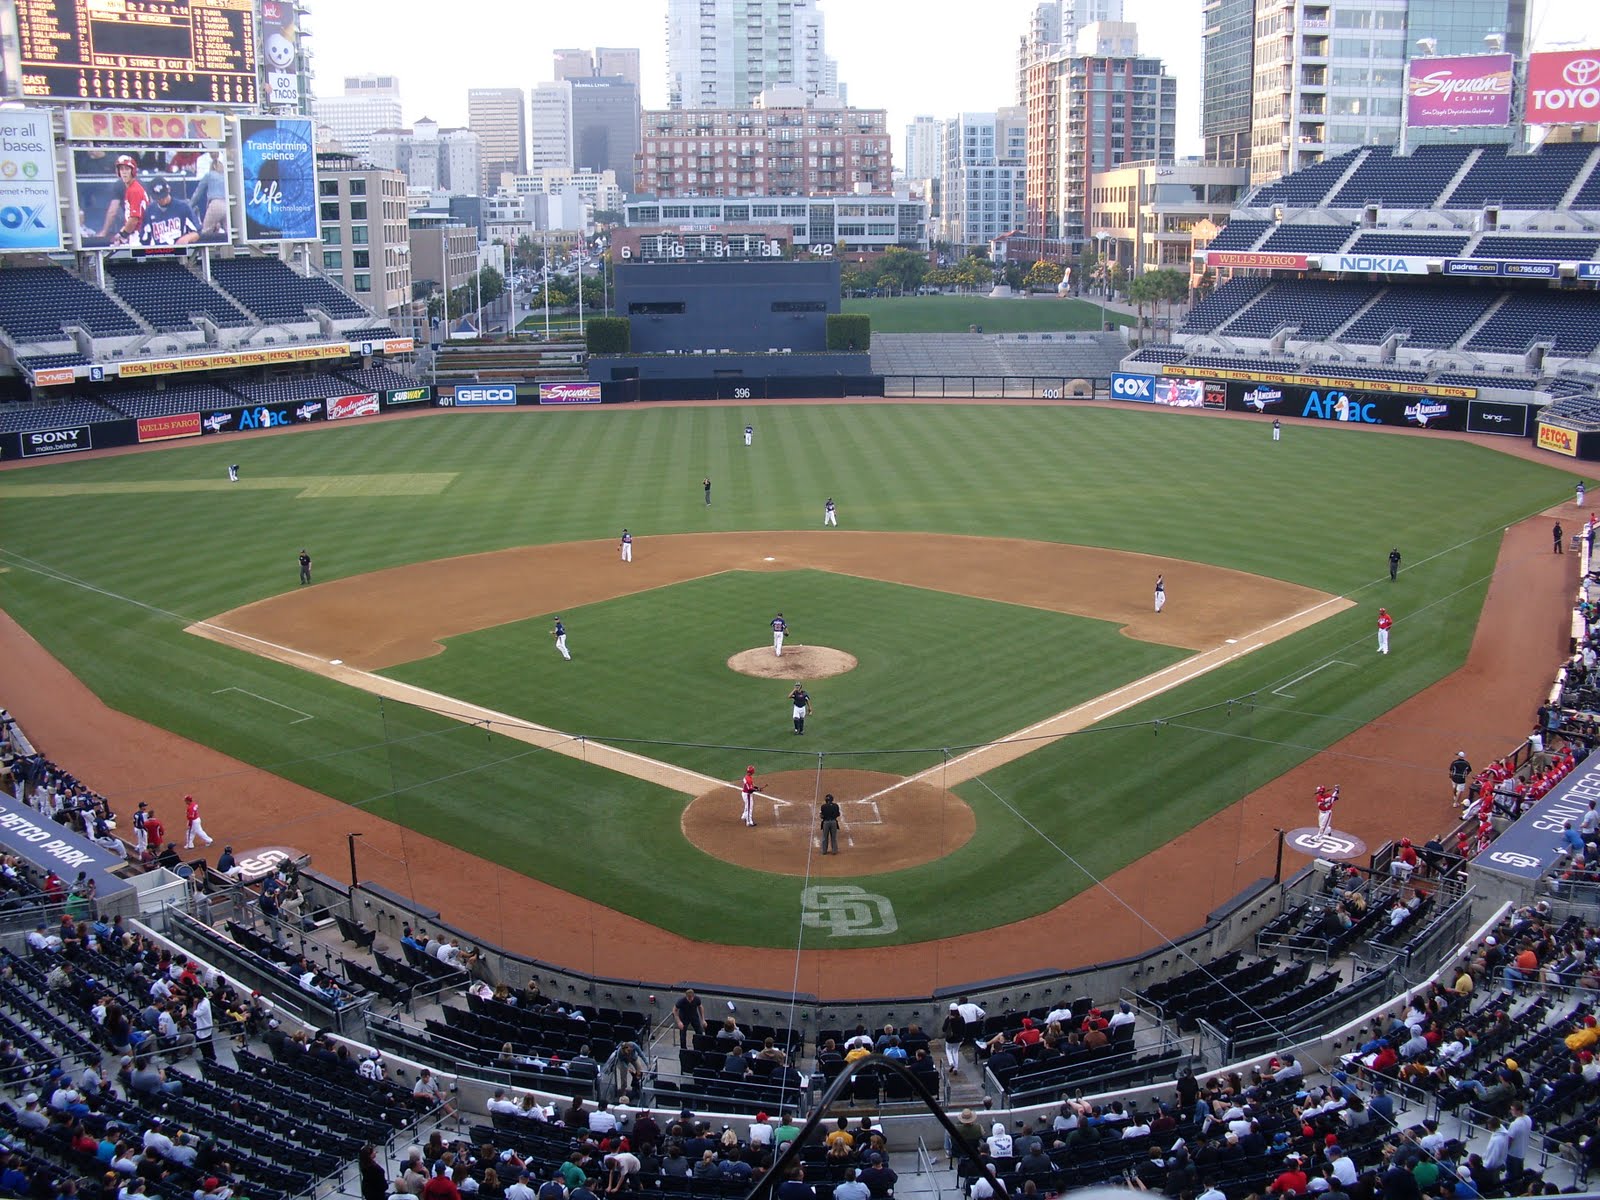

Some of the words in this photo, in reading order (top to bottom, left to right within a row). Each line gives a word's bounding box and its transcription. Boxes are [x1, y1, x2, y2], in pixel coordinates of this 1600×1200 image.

[96, 56, 116, 65] BALL
[130, 59, 156, 68] STRIKE
[168, 60, 183, 69] OUT
[22, 75, 47, 84] EAST
[277, 78, 290, 88] GO
[22, 86, 50, 95] WEST
[1414, 71, 1506, 102] Sycuan
[273, 90, 296, 100] TACOS
[1532, 88, 1600, 110] TOYO
[19, 124, 35, 136] all
[92, 114, 186, 138] PETCO
[4, 139, 46, 152] bases.
[248, 140, 307, 154] Transforming
[261, 151, 294, 160] science
[25, 187, 48, 196] Phone
[248, 180, 283, 214] life
[152, 217, 180, 238] AFLAC
[622, 246, 630, 258] 6
[670, 245, 684, 257] 19
[714, 245, 730, 257] 31
[812, 244, 832, 256] 42
[1220, 255, 1255, 263] WELLS
[1259, 256, 1296, 264] FARGO
[1340, 258, 1408, 272] NOKIA
[386, 342, 412, 351] CYMER
[38, 372, 73, 382] CYMER
[548, 386, 593, 401] Sycuan
[735, 388, 750, 399] 396
[1043, 389, 1058, 398] 400
[1114, 377, 1151, 398] COX
[392, 390, 424, 401] SUBWAY
[458, 390, 513, 400] GEICO
[1207, 394, 1224, 402] XX
[1243, 392, 1255, 401] ALL
[1258, 391, 1281, 400] AMERICAN
[330, 395, 377, 418] Budweiser
[439, 398, 453, 406] 401
[1404, 406, 1417, 415] ALL
[1420, 403, 1446, 413] AMERICAN
[1482, 413, 1502, 422] bing
[140, 421, 169, 432] WELLS
[171, 419, 198, 428] FARGO
[32, 430, 80, 444] SONY
[1541, 427, 1567, 444] PETCO
[36, 442, 77, 452] make.believe
[1532, 804, 1584, 833] SAN
[0, 813, 51, 842] PETCO
[39, 840, 96, 868] PARK
[800, 886, 898, 937] SD
